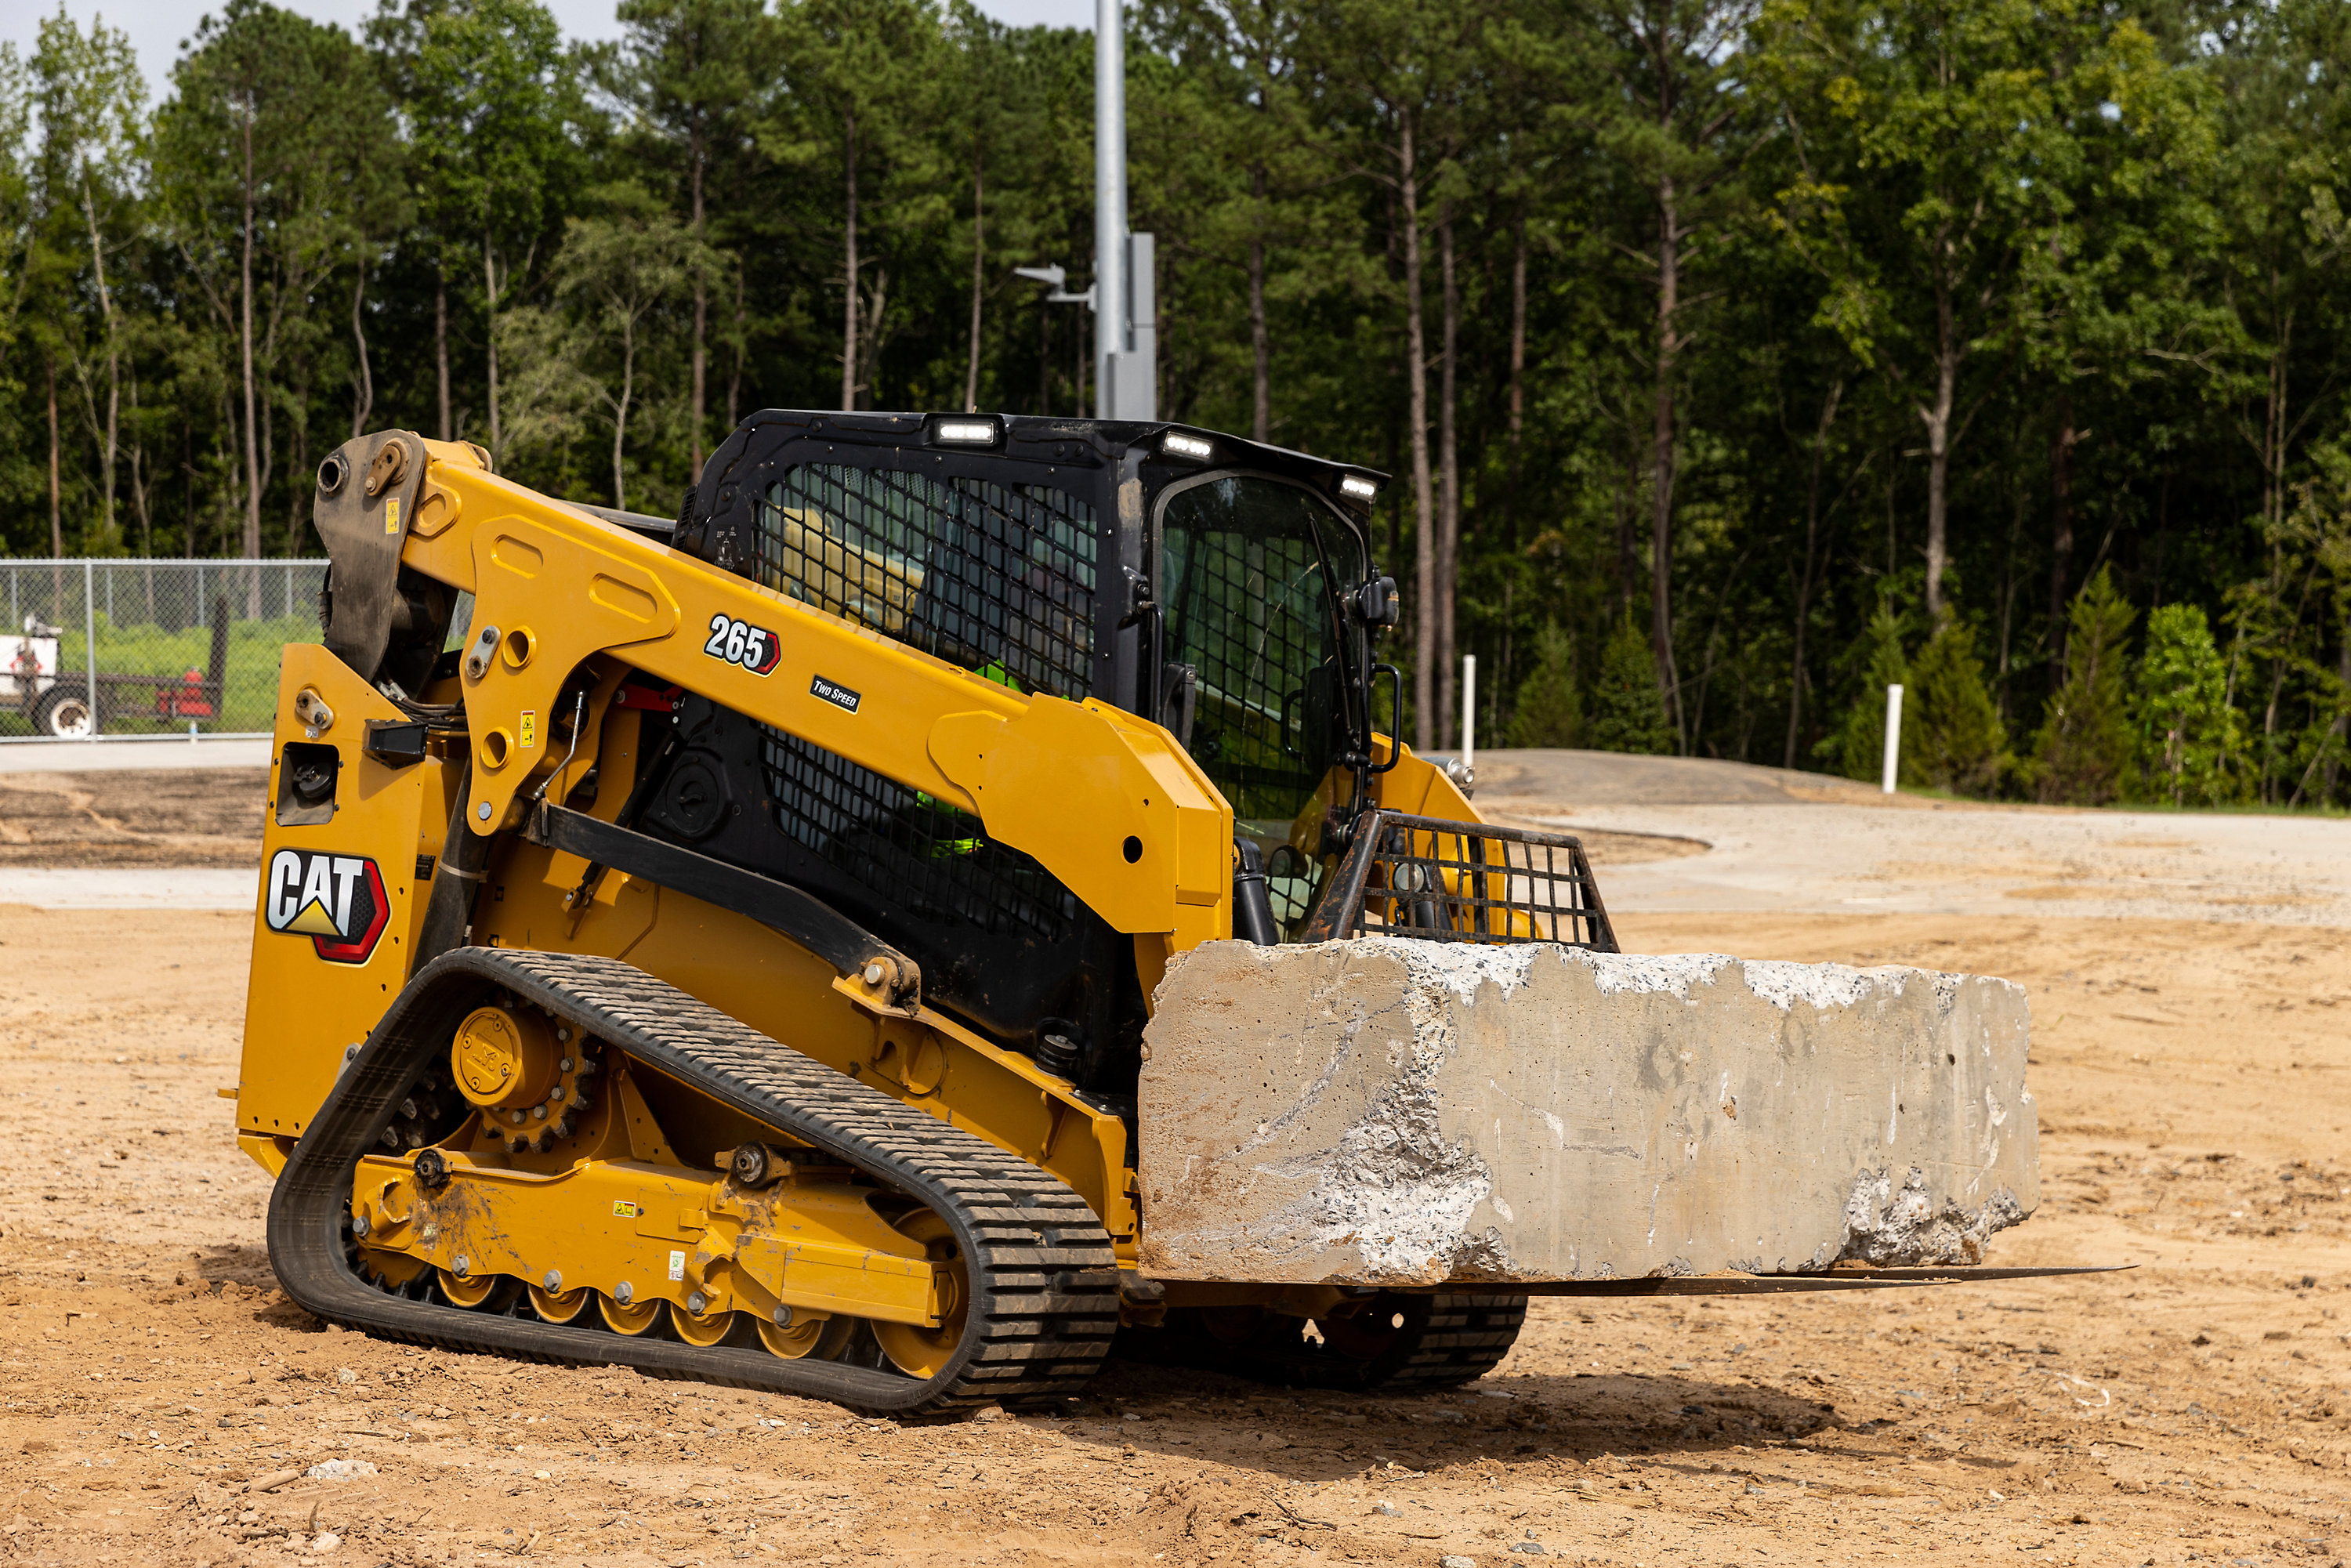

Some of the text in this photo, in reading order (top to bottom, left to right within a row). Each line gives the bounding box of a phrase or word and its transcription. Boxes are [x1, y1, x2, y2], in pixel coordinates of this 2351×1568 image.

[706, 615, 766, 668] 265
[813, 680, 857, 707] TWO SPEED
[267, 850, 364, 936] CAT
